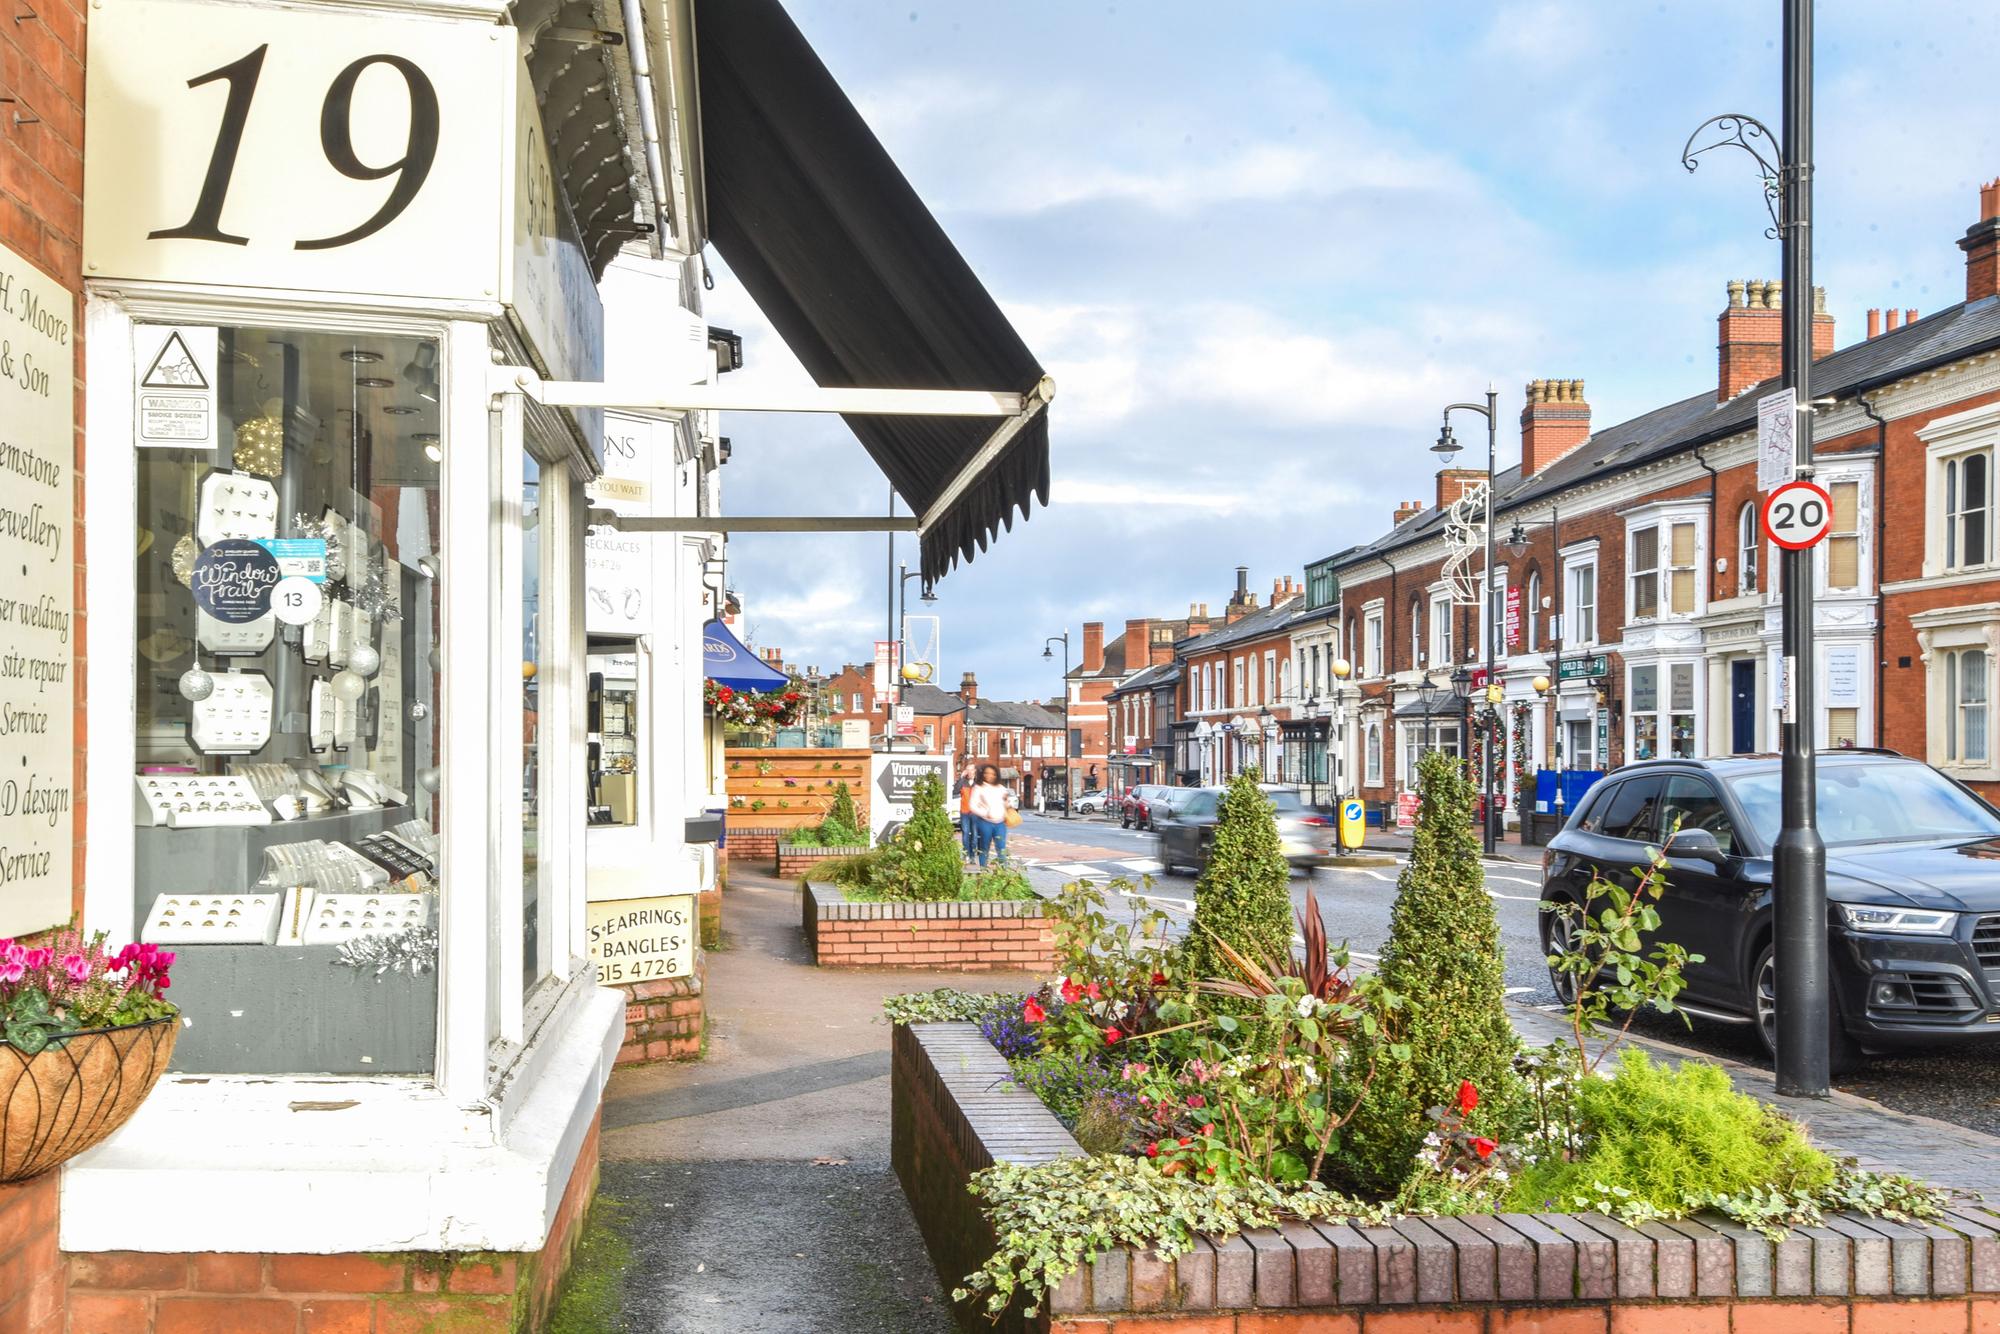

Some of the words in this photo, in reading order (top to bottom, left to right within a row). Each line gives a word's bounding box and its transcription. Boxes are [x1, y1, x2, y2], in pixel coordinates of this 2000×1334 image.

[147, 43, 440, 250] 19
[20, 288, 68, 347] Moore
[1, 340, 14, 379] &
[20, 353, 49, 398] Son
[599, 482, 618, 493] YOU
[621, 484, 643, 496] WAIT
[1774, 500, 1823, 530] 20
[192, 561, 281, 585] Window
[198, 580, 273, 605] Trail
[283, 592, 303, 607] 13
[19, 597, 69, 644] welding
[1, 645, 25, 679] site
[28, 653, 67, 693] repair
[0, 702, 48, 736] Service
[934, 766, 942, 775] &
[22, 773, 69, 828] design
[0, 840, 50, 888] Service
[586, 925, 600, 942] S
[606, 909, 682, 936] EARRINGS
[603, 936, 679, 958] BANGLES
[597, 963, 622, 982] 515
[630, 958, 677, 978] 4726
